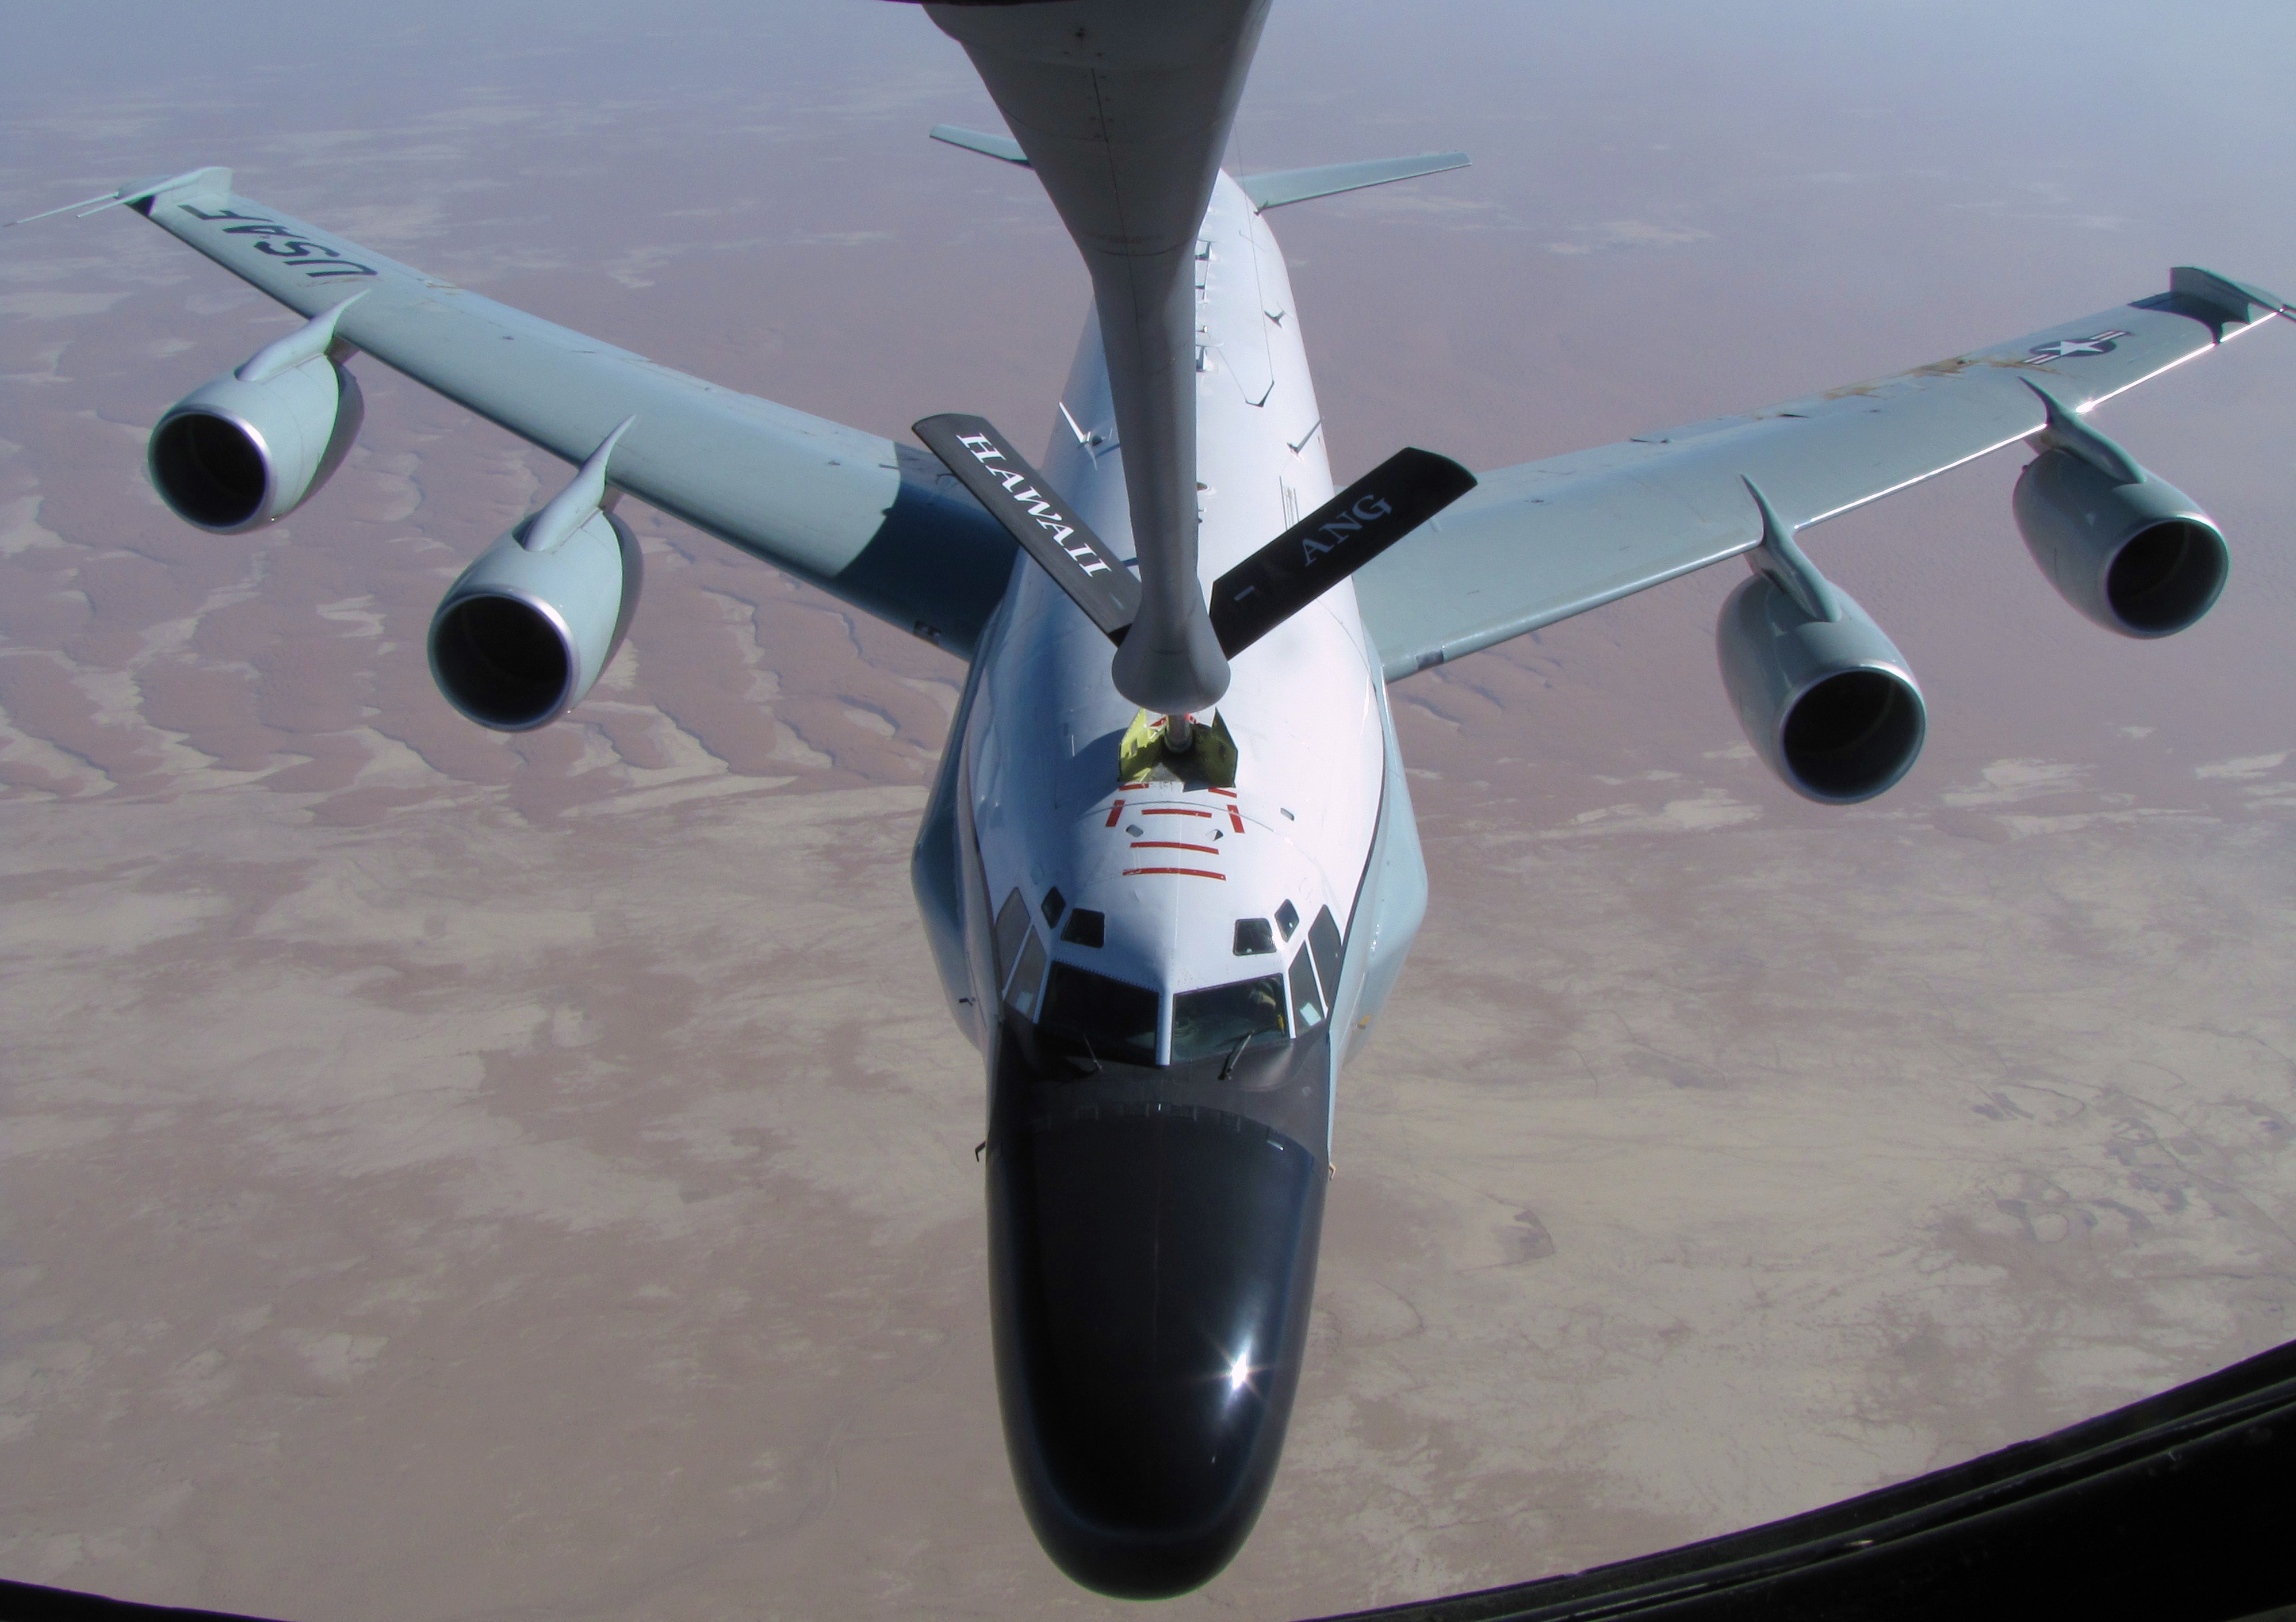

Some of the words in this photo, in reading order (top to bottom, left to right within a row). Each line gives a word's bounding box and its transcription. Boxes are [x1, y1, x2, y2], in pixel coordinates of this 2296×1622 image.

[177, 204, 378, 278] USAF
[956, 433, 1112, 577] HAWAII
[1299, 494, 1392, 567] ANG
